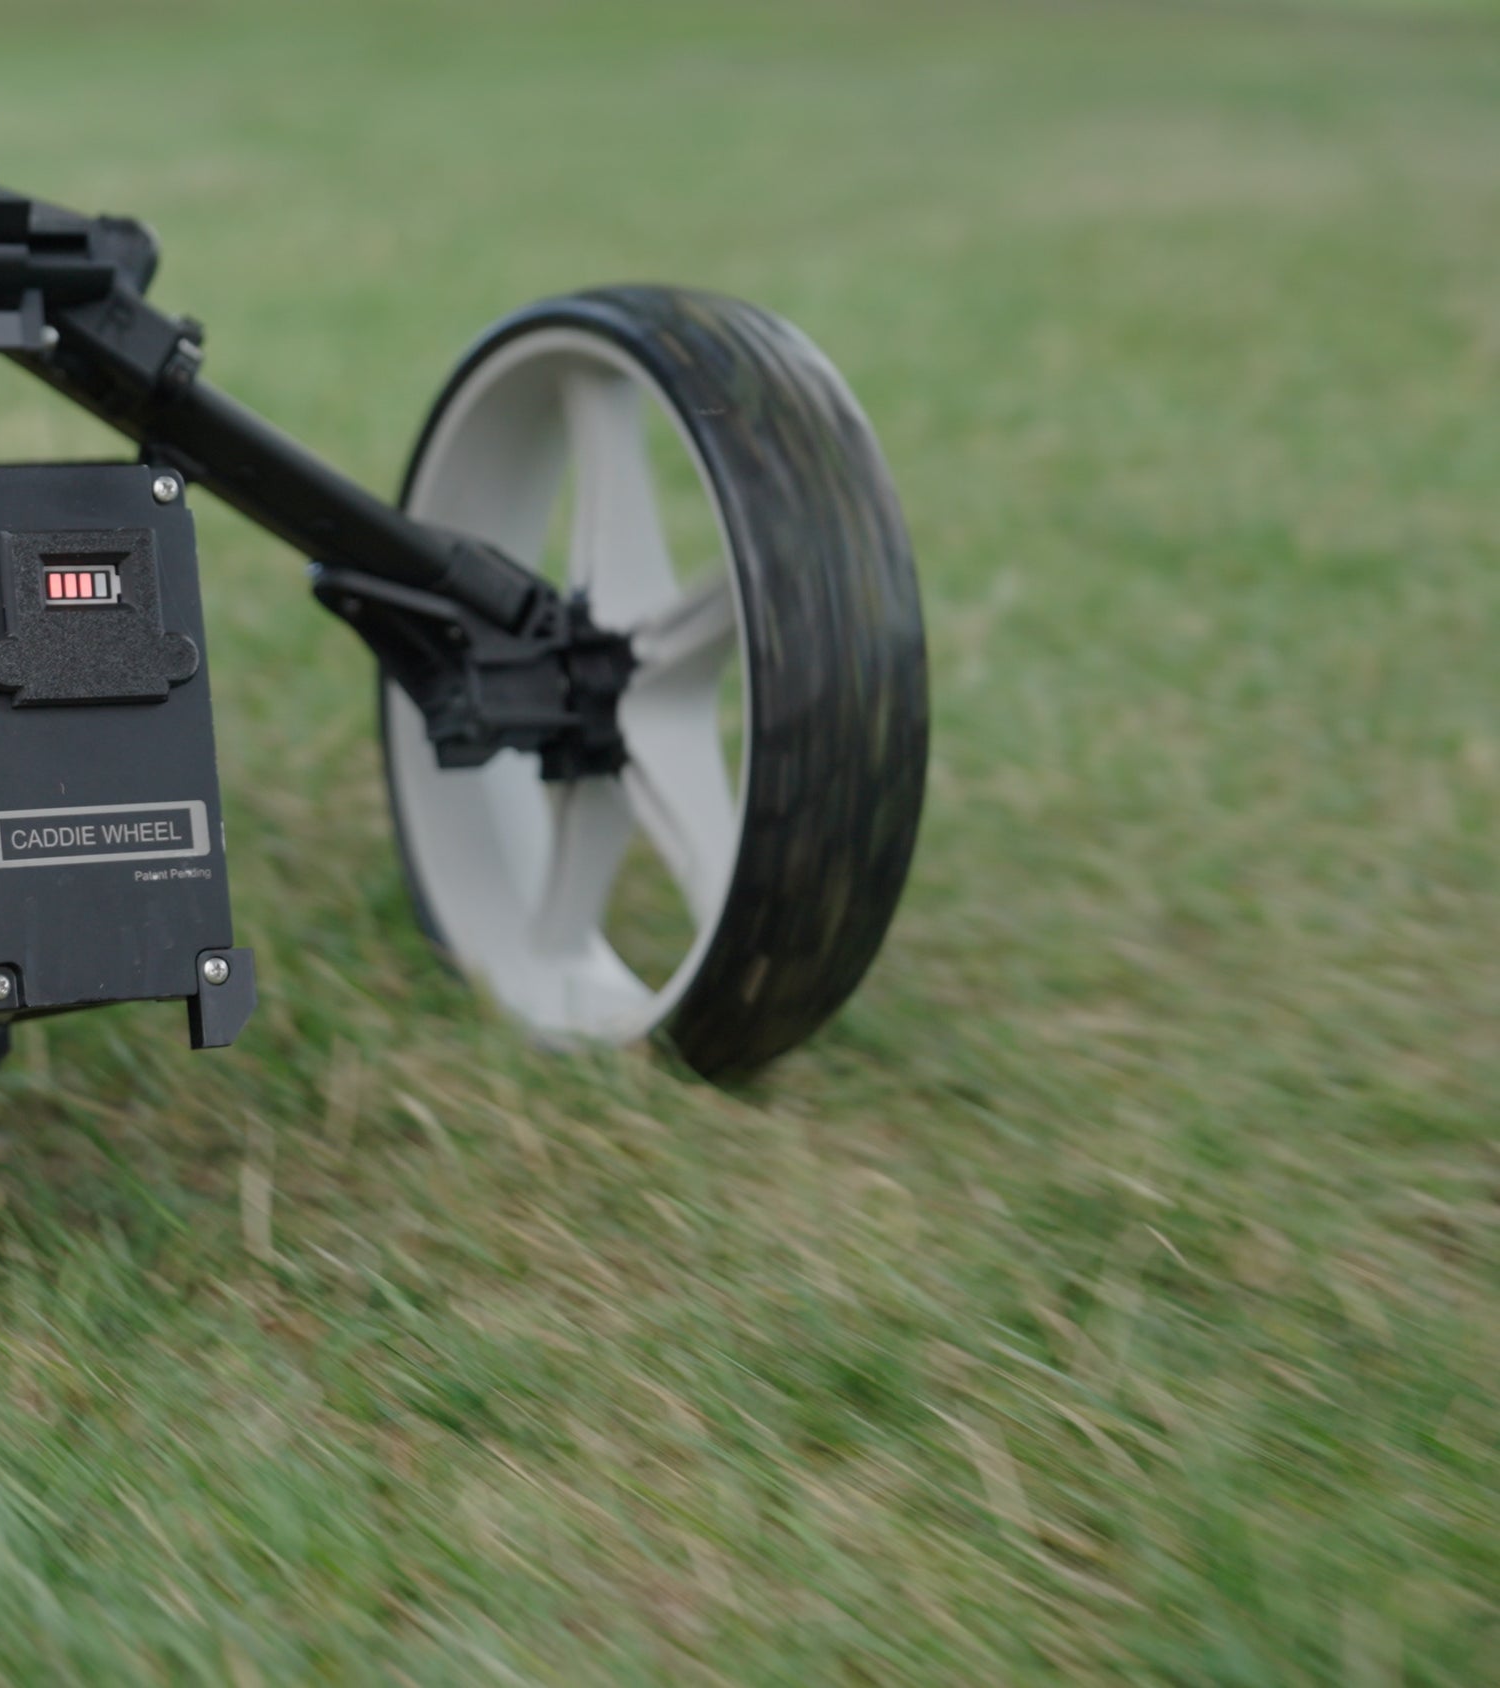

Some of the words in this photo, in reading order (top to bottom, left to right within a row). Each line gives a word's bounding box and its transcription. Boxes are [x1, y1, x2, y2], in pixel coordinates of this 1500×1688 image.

[11, 826, 96, 850] CADDIE
[101, 822, 182, 845] WHEEL
[170, 867, 212, 880] Pending
